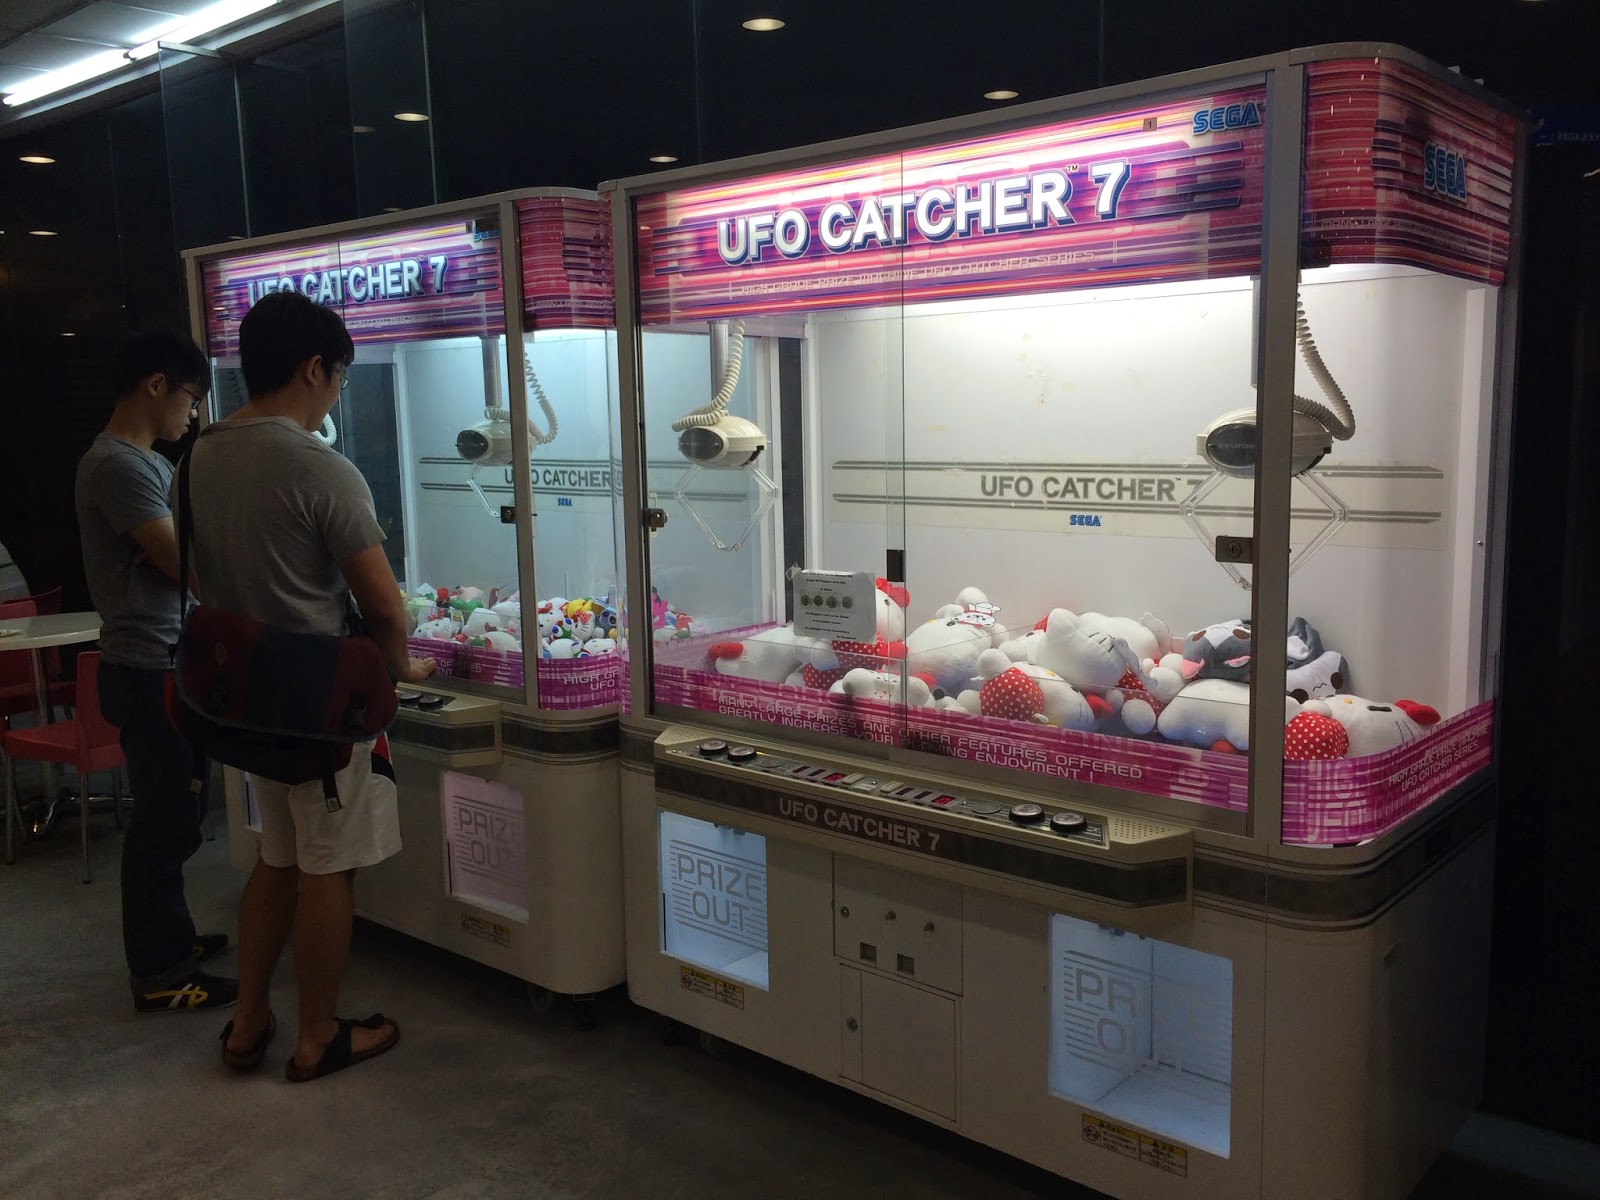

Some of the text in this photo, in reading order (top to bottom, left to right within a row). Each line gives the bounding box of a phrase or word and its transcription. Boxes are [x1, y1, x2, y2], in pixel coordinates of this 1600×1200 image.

[1192, 101, 1261, 135] SEGA
[1424, 140, 1467, 203] SEGA
[718, 208, 811, 266] UFO
[819, 168, 1077, 254] CATCHER
[1089, 158, 1132, 221] 7
[301, 258, 424, 306] CATCHER
[428, 254, 449, 296] 7
[542, 469, 612, 488] CATCHER
[980, 475, 1033, 498] UFO
[1040, 476, 1177, 502] CATCHER
[1069, 514, 1101, 527] SEGA
[563, 673, 599, 685] HIGH
[590, 678, 616, 691] UFO
[718, 695, 754, 709] MANY
[758, 702, 801, 718] LARGE
[807, 710, 857, 728] PRIZES
[863, 720, 892, 735] AND
[958, 737, 1047, 762] FEATURES
[1055, 755, 1142, 779] OFFERED
[719, 705, 776, 723] GREATLY
[781, 713, 849, 736] INCREASE
[854, 730, 894, 746] YOUR
[975, 751, 1081, 779] ENJOYMENT
[1401, 774, 1418, 791] UFO
[1419, 754, 1453, 781] CATCHER
[779, 797, 941, 851] UFO CATCHER 7
[677, 852, 763, 904] PRIZE
[691, 890, 751, 932] OUT
